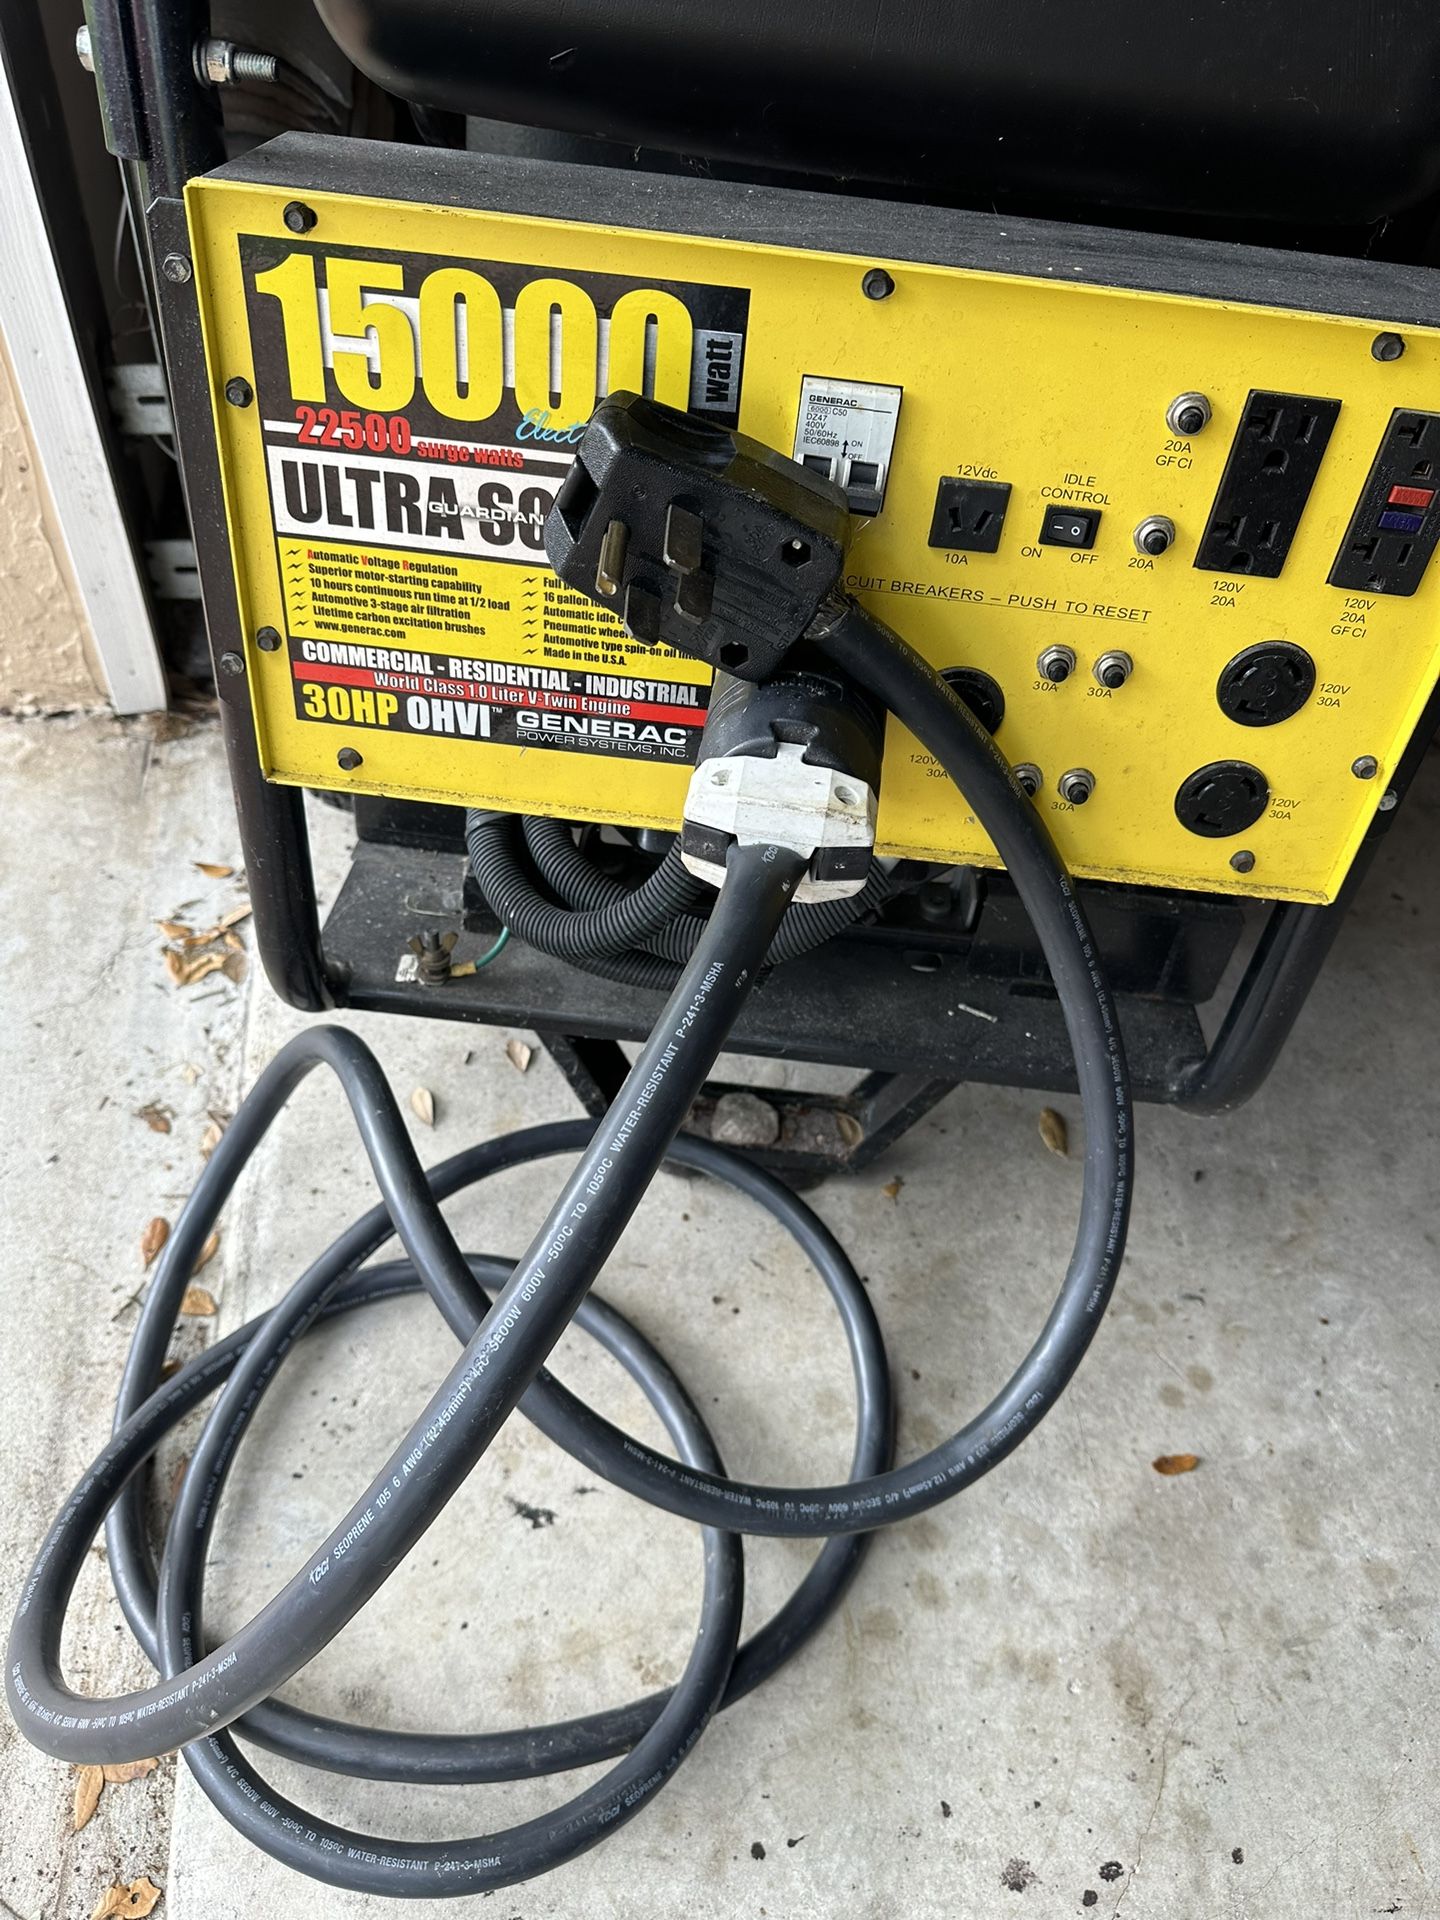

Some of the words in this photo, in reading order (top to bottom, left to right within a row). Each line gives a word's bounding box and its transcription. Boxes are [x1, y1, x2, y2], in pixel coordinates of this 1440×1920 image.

[255, 253, 694, 427] 15000
[705, 338, 734, 404] watt
[809, 394, 858, 407] GENERAC
[806, 413, 828, 422] DZ47
[810, 406, 829, 414] 6000
[832, 407, 848, 417] C50
[516, 408, 588, 444] Elect
[805, 421, 826, 430] 400V
[295, 405, 412, 455] 22500
[417, 441, 469, 466] surge
[473, 448, 524, 468] watts
[804, 428, 838, 440] 50/60Hz
[803, 436, 840, 448] IEC60898
[851, 440, 864, 448] ON
[1164, 439, 1191, 453] 20A
[847, 452, 863, 460] OFF
[1155, 455, 1193, 469] GFCI
[957, 464, 998, 480] 12Vdc
[1063, 473, 1096, 488] IDLE
[1040, 486, 1111, 506] CONTROL
[281, 460, 465, 541] ULTRA
[477, 482, 554, 550] SO
[428, 501, 544, 525] GUARDIAN
[944, 553, 969, 566] 10A
[1021, 546, 1043, 559] ON
[1070, 552, 1099, 565] OFF
[307, 549, 359, 565] Automatic
[360, 555, 400, 570] Voltage
[402, 560, 458, 576] Regulation
[1128, 557, 1154, 570] 20A
[308, 563, 352, 578] Superior
[354, 571, 429, 588] motor-starting
[431, 579, 482, 594] capability
[543, 577, 562, 589] Full
[310, 577, 322, 588] 10
[323, 579, 353, 592] hours
[355, 583, 412, 599] continuous
[413, 591, 431, 601] run
[433, 592, 456, 604] time
[458, 596, 468, 606] at
[470, 596, 486, 609] 1/2
[488, 599, 510, 611] load
[1212, 580, 1246, 593] 120V
[311, 591, 368, 608] Automotive
[370, 599, 408, 613] 3-stage
[410, 603, 424, 614] air
[426, 604, 471, 620] filtration
[543, 592, 555, 602] 16
[557, 594, 589, 606] gallon
[846, 575, 886, 589] CUIT
[890, 580, 985, 602] BREAKERS
[1007, 594, 1057, 611] PUSH
[1065, 601, 1088, 614] TO
[1093, 605, 1152, 622] RESET
[1210, 595, 1235, 607] 20A
[1344, 597, 1376, 610] 120V
[313, 605, 353, 619] Lifetime
[355, 612, 391, 624] carbon
[393, 616, 443, 630] excitation
[445, 621, 486, 636] brushes
[543, 606, 595, 621] Automatic
[596, 611, 616, 624] idle
[1340, 612, 1366, 624] 20A
[314, 620, 406, 639] www.generac.com
[543, 620, 597, 636] Pneumatic
[1330, 625, 1367, 638] GFCI
[543, 633, 599, 650] Automotive
[601, 640, 622, 652] type
[624, 643, 662, 657] spin-on
[664, 648, 677, 658] oil
[543, 646, 571, 660] Made
[572, 649, 582, 660] in
[584, 651, 600, 662] the
[602, 653, 627, 666] U.S.A.
[302, 640, 434, 675] COMMERCIAL
[449, 658, 570, 692] RESIDENTIAL
[586, 675, 699, 706] INDUSTRIAL
[373, 671, 420, 691] World
[423, 677, 464, 695] Class
[468, 684, 486, 698] 1.0
[491, 687, 524, 704] Liter
[528, 691, 577, 710] V-Twin
[581, 697, 631, 716] Engine
[1032, 680, 1058, 692] 30A
[1086, 687, 1112, 699] 30A
[1319, 683, 1351, 695] 120V
[302, 683, 399, 726] 30HP
[1316, 696, 1341, 708] 30A
[516, 710, 687, 745] GENERAC
[516, 730, 575, 745] POWER
[578, 733, 656, 755] SYSTEMS,
[659, 746, 689, 758] INC.
[926, 768, 948, 778] 30A
[1051, 801, 1075, 812] 30A
[1270, 798, 1301, 809] 120V
[1268, 809, 1292, 820] 30A
[1067, 900, 1088, 942] SEOPRENE
[1118, 1137, 1127, 1149] TO
[1106, 1181, 1125, 1254] WATER-RESISTANT
[333, 1508, 376, 1559] SEOPRENE
[375, 1487, 392, 1510] 105
[392, 1476, 401, 1488] 6
[401, 1447, 423, 1477] AWG
[521, 1268, 547, 1302] 600V
[571, 1201, 588, 1220] TO
[609, 1042, 680, 1154] WATER-RESISTANT
[675, 960, 725, 1039] P-241-3-MSHA
[679, 1474, 751, 1506] WATER-RESISTANT
[136, 1685, 191, 1719] WATER-RESISTANT
[191, 1651, 238, 1692] P-241-3-MSHA
[624, 1771, 663, 1807] SEOPRENE
[226, 1764, 239, 1778] 4/C
[237, 1778, 261, 1803] SEOOW
[259, 1801, 280, 1818] 600V
[305, 1830, 317, 1842] TO
[347, 1847, 429, 1871] WATER-RESISTANT
